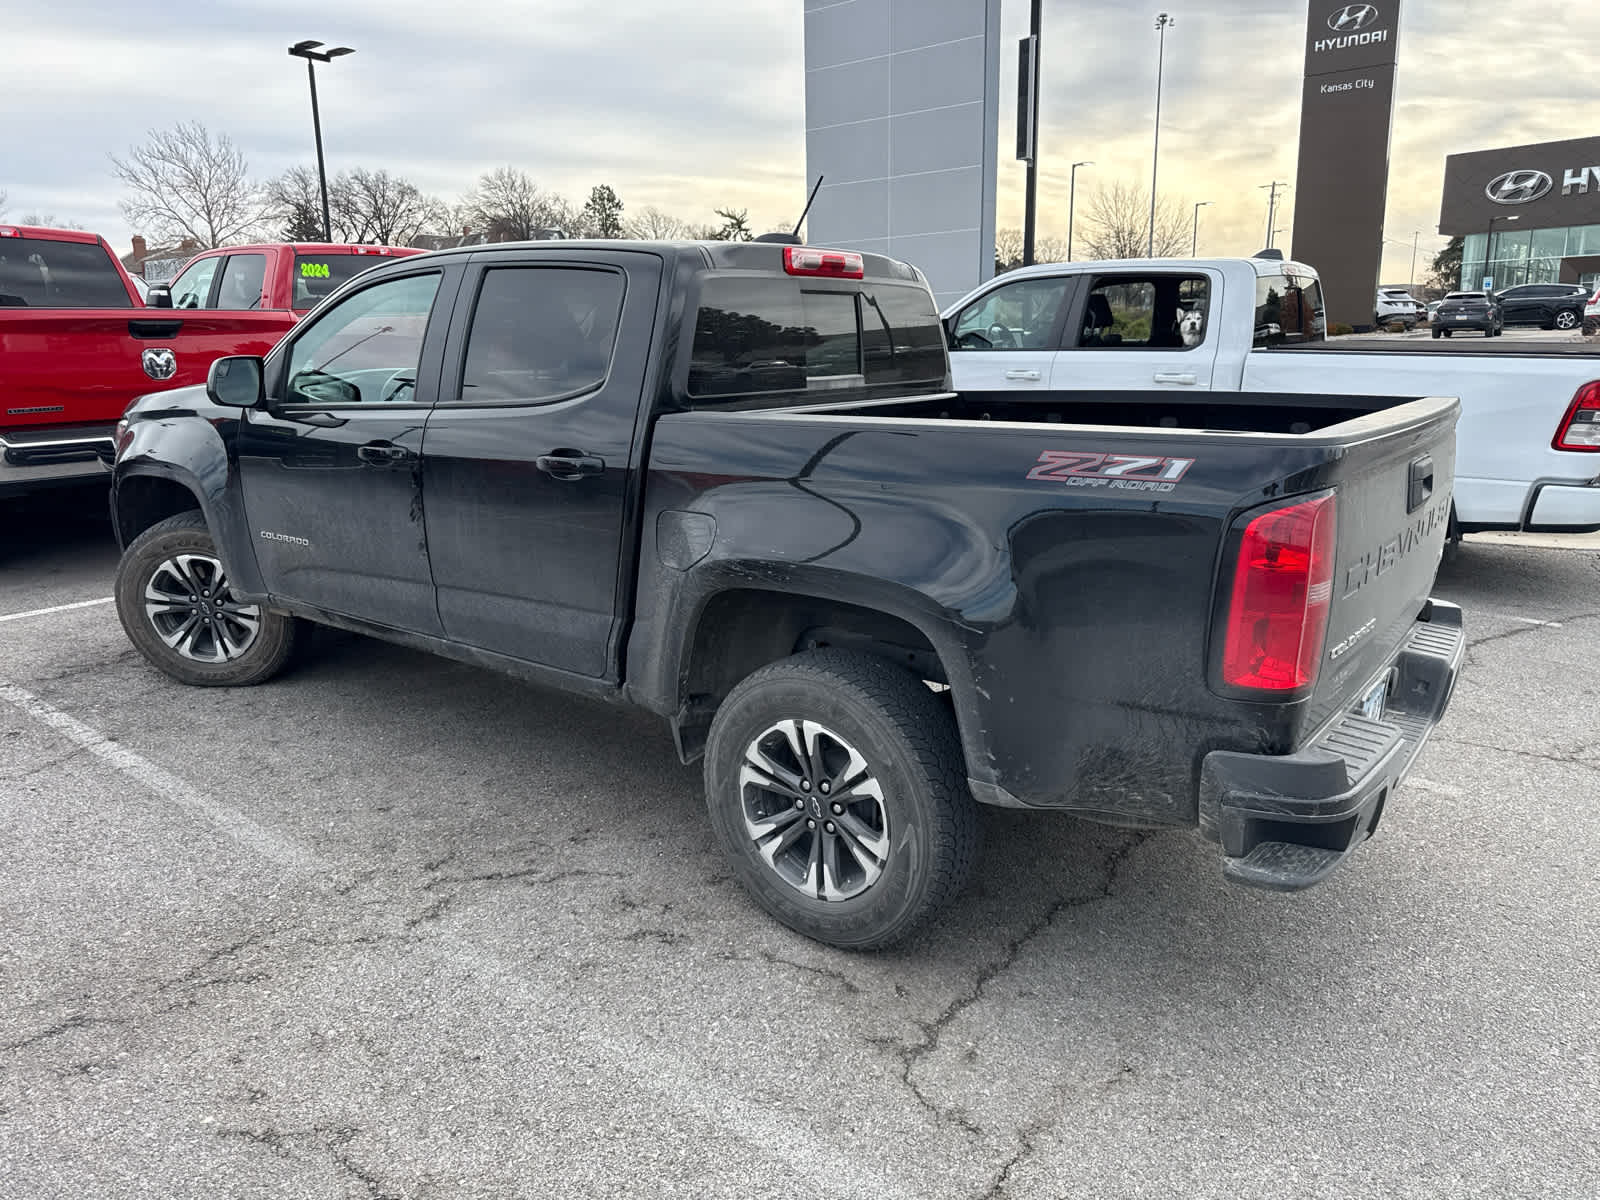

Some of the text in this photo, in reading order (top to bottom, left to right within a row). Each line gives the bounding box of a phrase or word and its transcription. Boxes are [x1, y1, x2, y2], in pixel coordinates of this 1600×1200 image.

[1314, 30, 1387, 52] HYUNDAI
[1320, 79, 1375, 94] Kansas City
[301, 263, 329, 278] 2024
[1026, 450, 1196, 483] Z71
[260, 530, 309, 546] COLORADO
